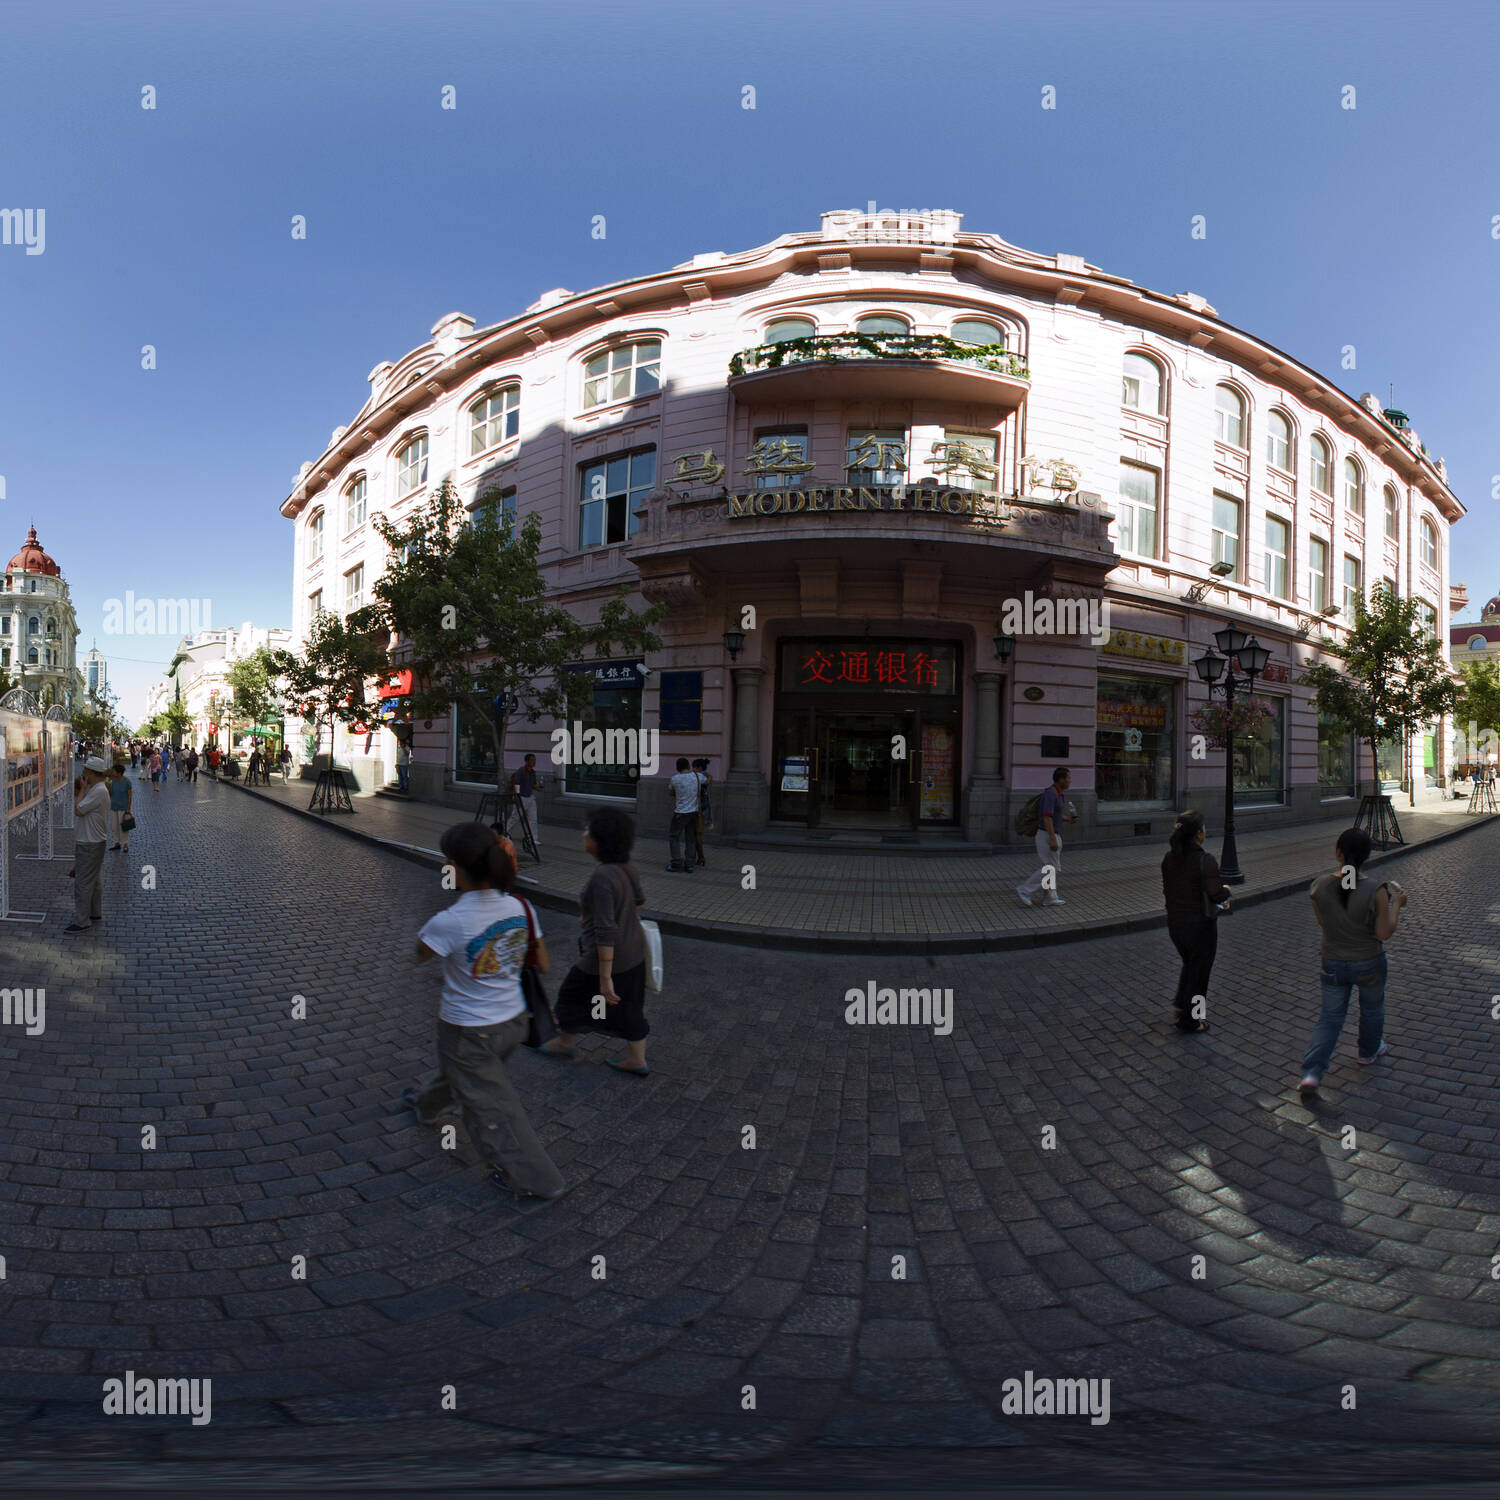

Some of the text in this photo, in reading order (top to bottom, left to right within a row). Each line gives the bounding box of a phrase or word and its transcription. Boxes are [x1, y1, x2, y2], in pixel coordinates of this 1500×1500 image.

[664, 433, 1083, 492] 马迭尔宾馆
[727, 487, 883, 519] MODERN
[800, 650, 940, 686] 交通银行
